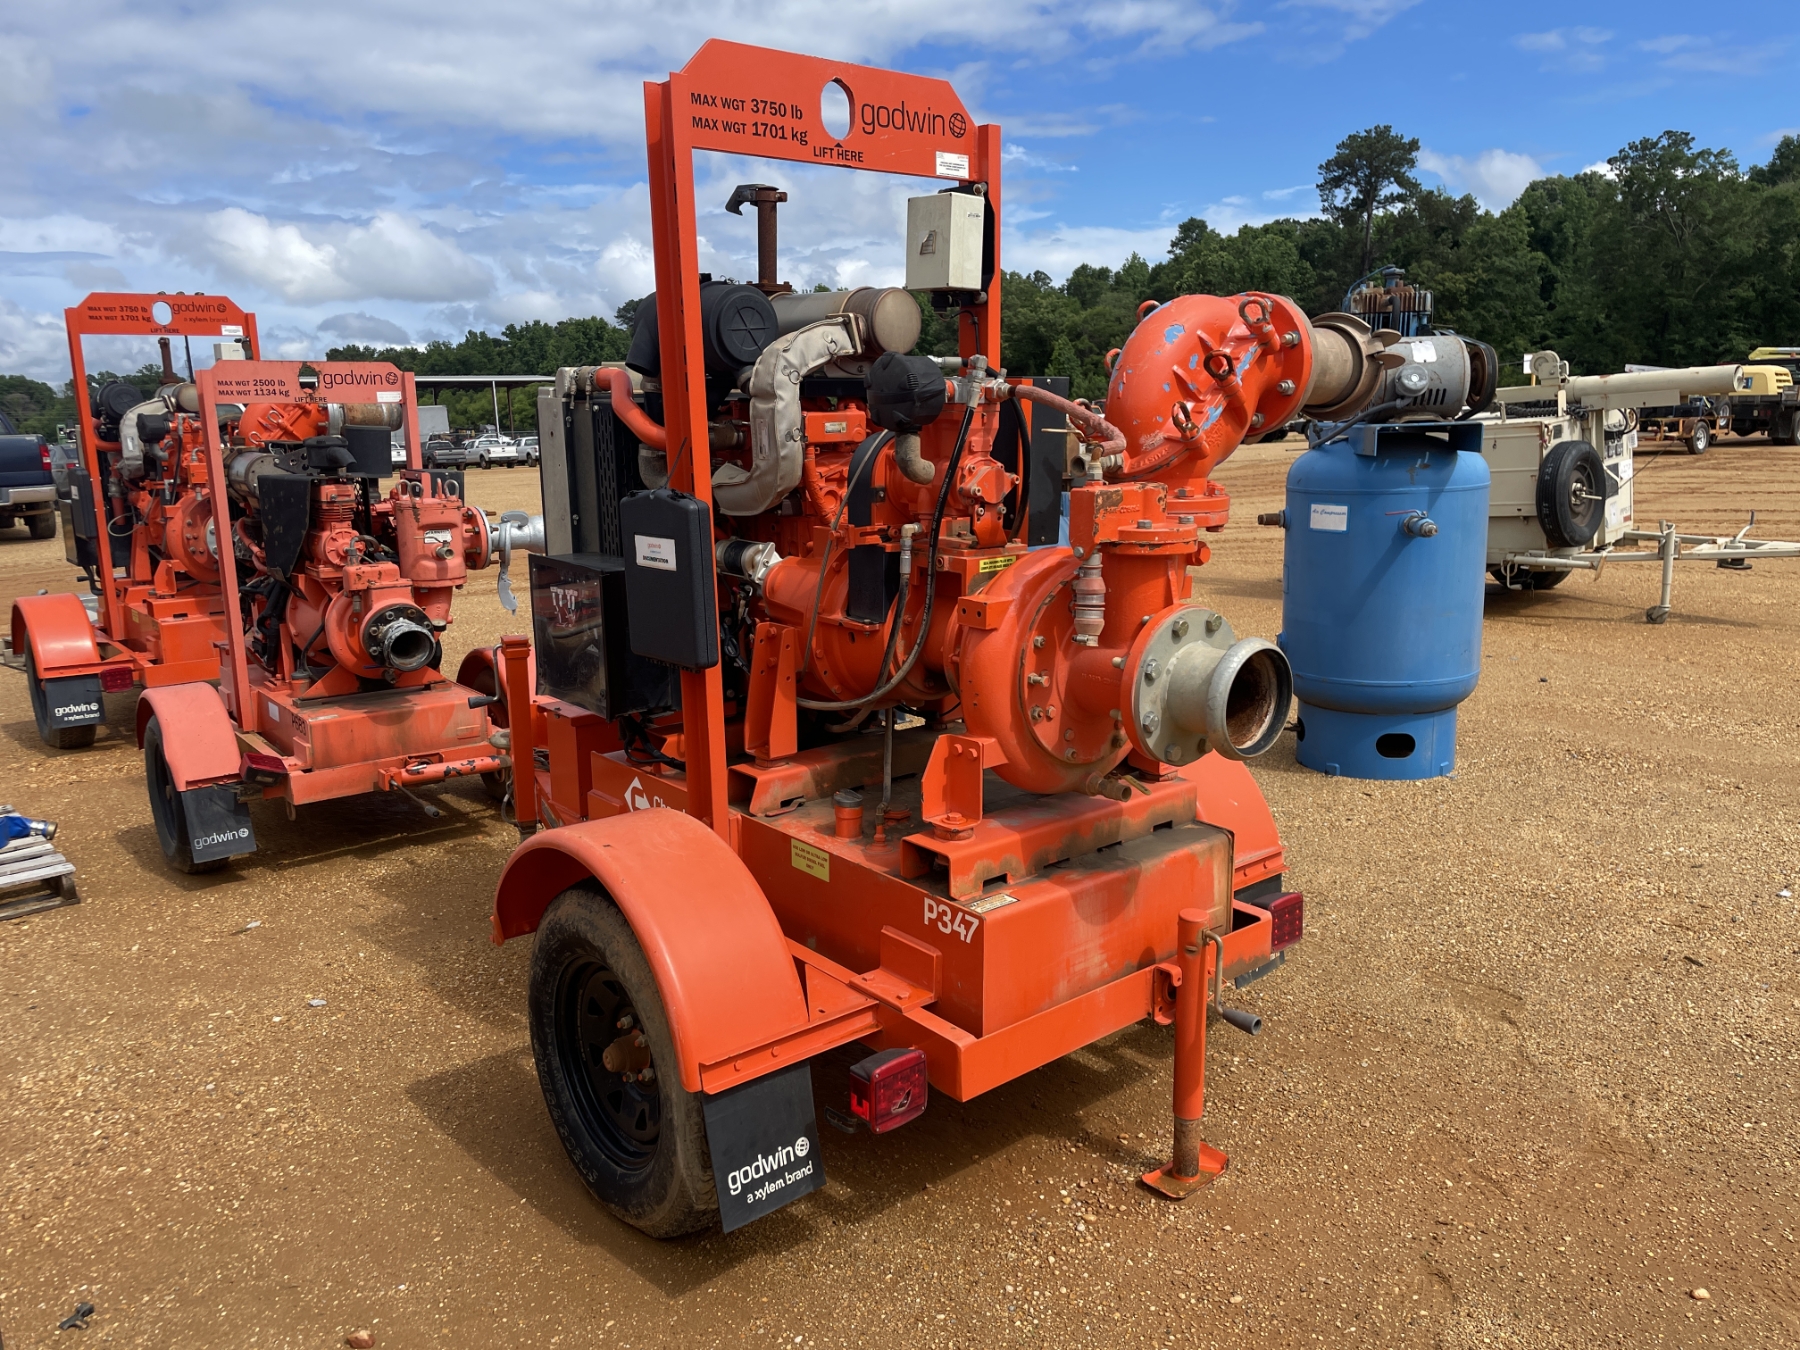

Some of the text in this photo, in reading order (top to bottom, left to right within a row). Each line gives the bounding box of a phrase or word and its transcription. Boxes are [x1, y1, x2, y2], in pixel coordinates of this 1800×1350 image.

[691, 92, 803, 120] MAX WGT 3750 lb
[861, 100, 945, 136] godwin
[692, 116, 808, 146] MAX WGT 1701 kg
[813, 146, 864, 163] LIFT HERE
[119, 305, 138, 313] 3750
[172, 301, 216, 315] godwin
[120, 314, 139, 322] 1701
[142, 315, 151, 323] kg
[217, 379, 233, 387] MAX
[253, 379, 276, 387] 2500
[278, 379, 286, 387] lb
[322, 370, 383, 389] godwin
[253, 388, 276, 396] 1134
[278, 388, 290, 398] kg
[54, 703, 90, 717] godwin
[194, 830, 238, 850] godwin
[924, 897, 980, 944] P347
[728, 1146, 795, 1196] godwin
[747, 1160, 813, 1204] a xylem brand
